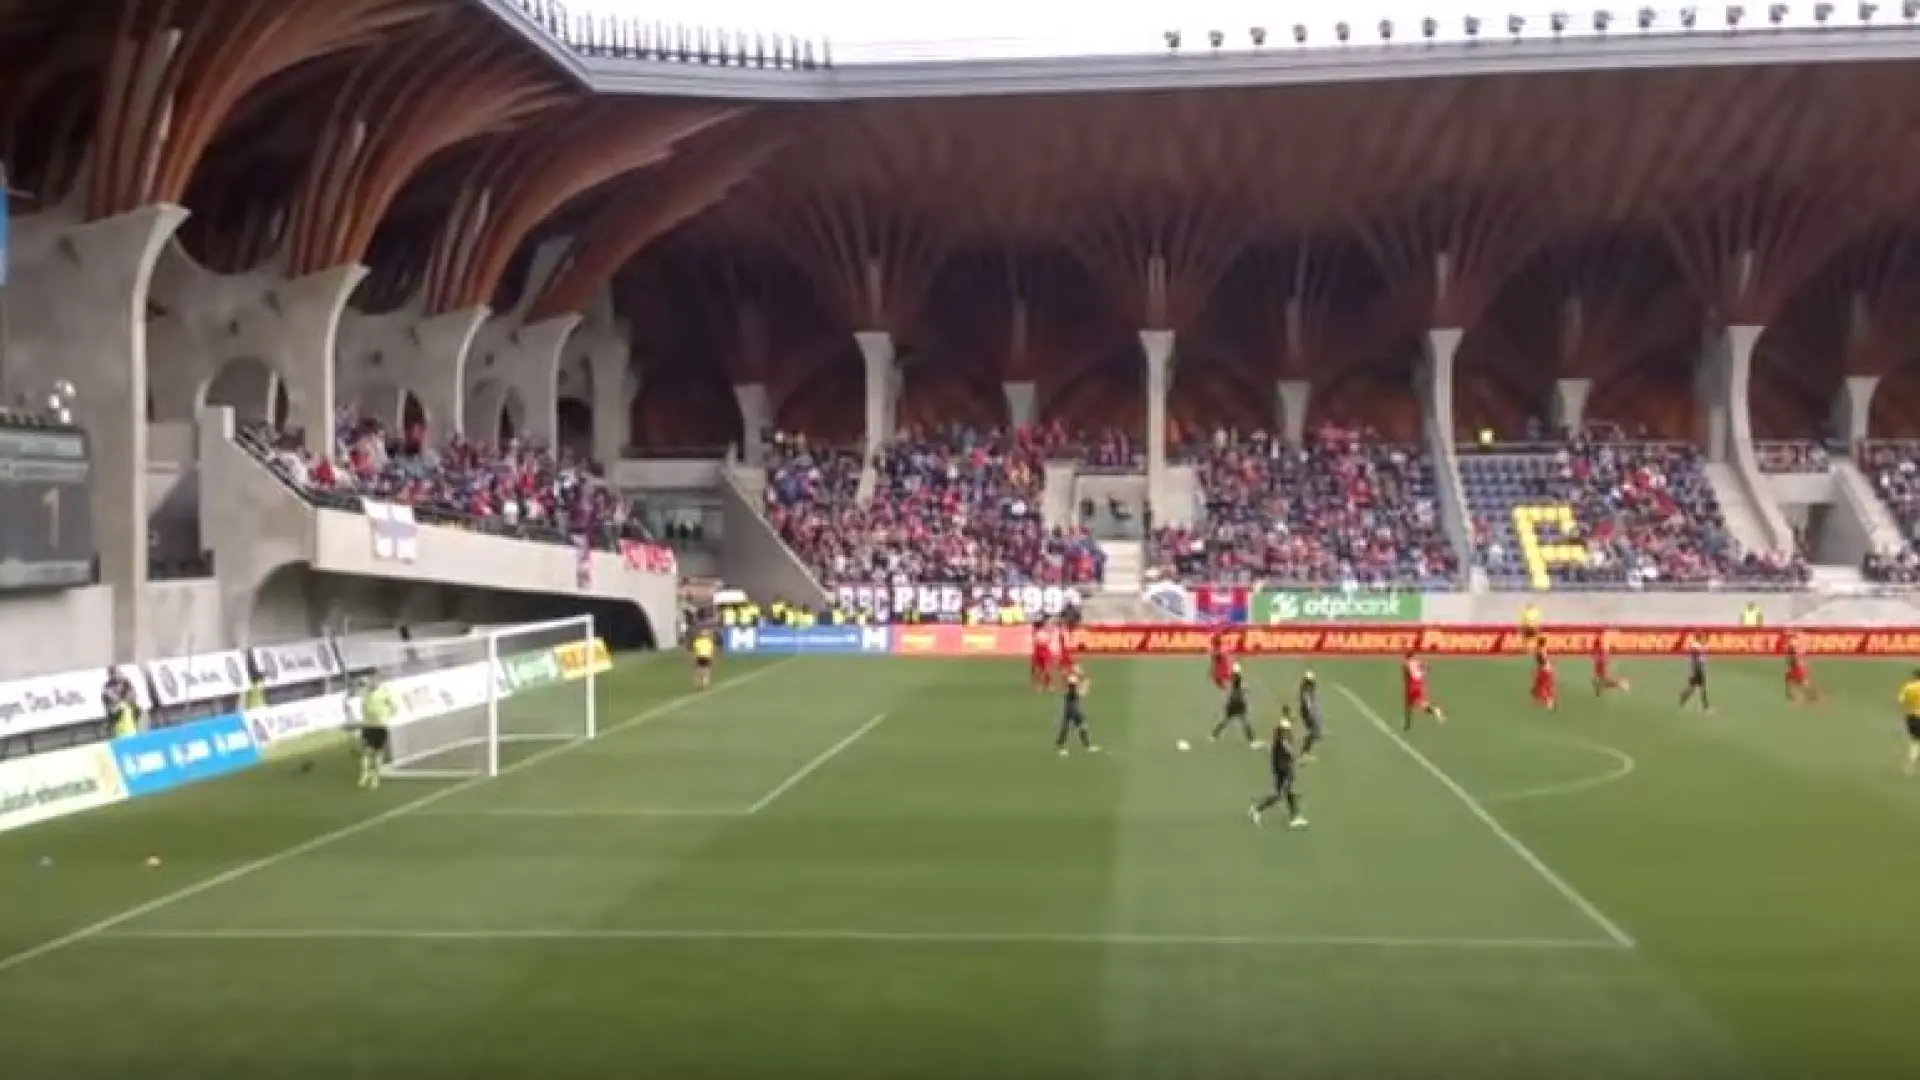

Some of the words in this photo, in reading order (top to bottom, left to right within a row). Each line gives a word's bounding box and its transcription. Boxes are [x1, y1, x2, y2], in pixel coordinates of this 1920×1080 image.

[1303, 593, 1400, 620] otpbank
[1146, 630, 1243, 652] MARKT
[1323, 630, 1421, 652] MARKET
[1500, 630, 1597, 652] MRKET
